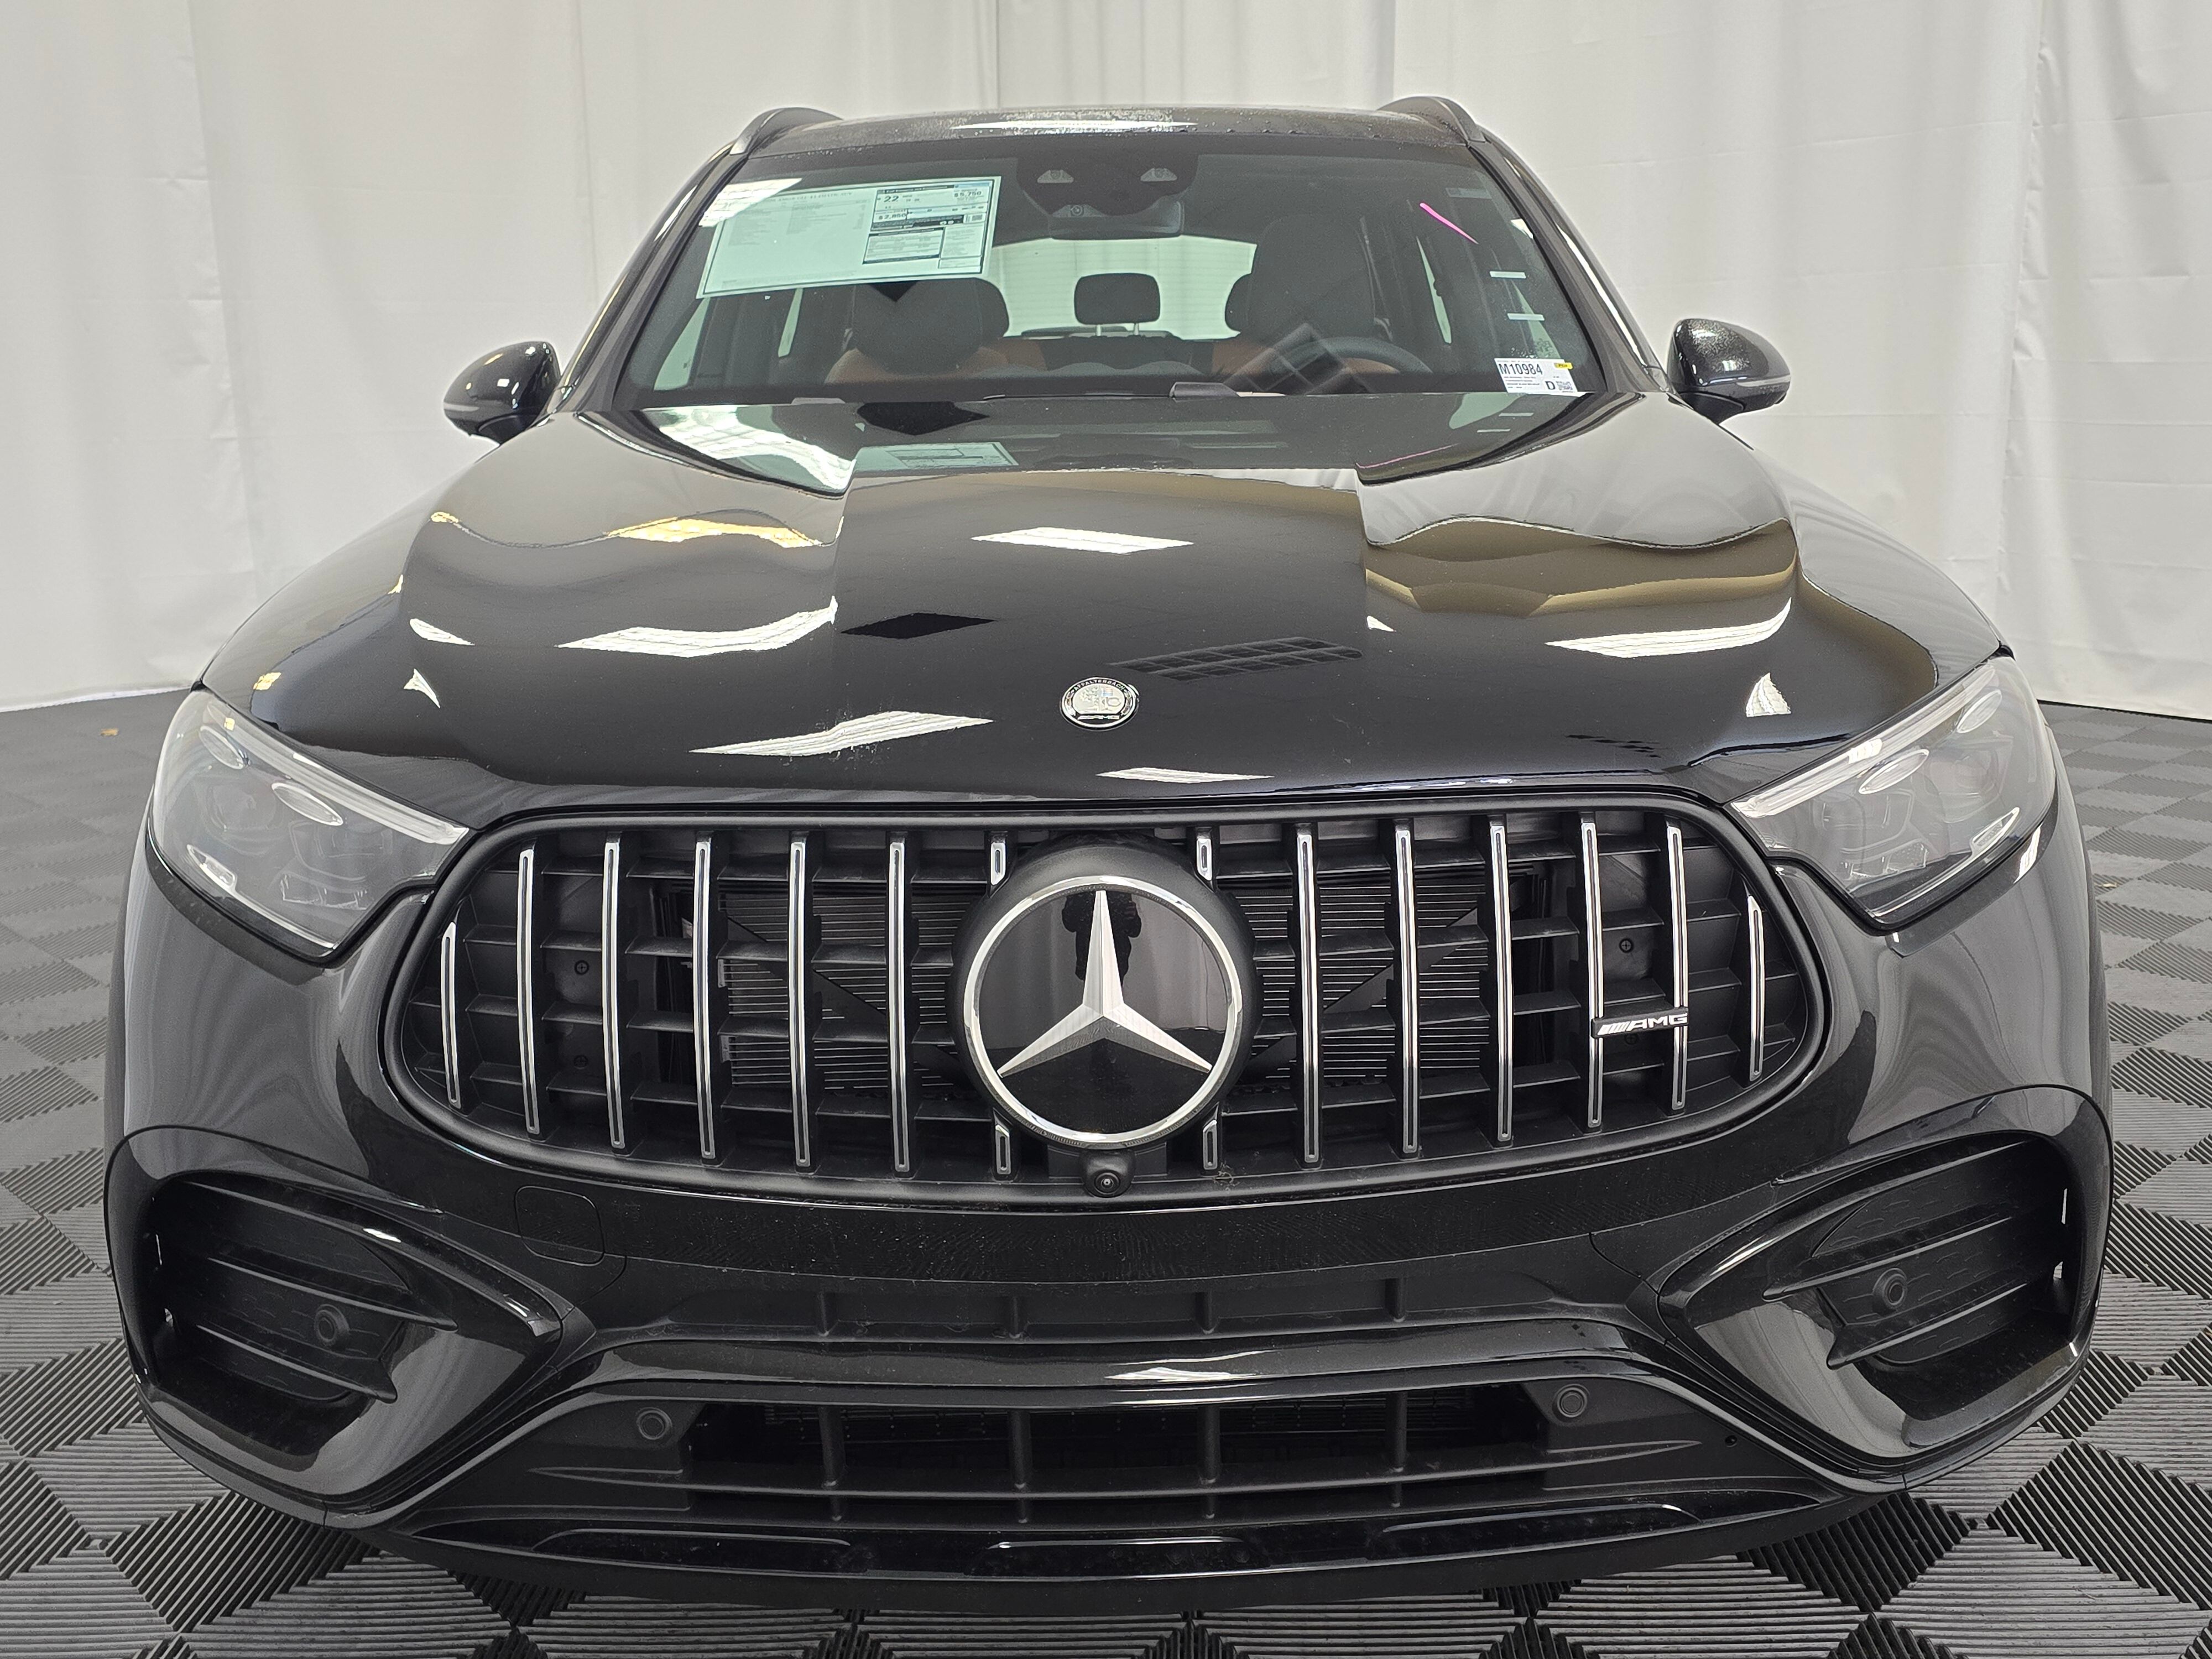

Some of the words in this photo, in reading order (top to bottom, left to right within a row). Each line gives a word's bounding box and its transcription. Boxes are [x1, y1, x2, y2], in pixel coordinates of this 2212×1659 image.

[1499, 363, 1543, 375] M10984
[1545, 381, 1556, 390] D
[1626, 1013, 1687, 1031] AMG
